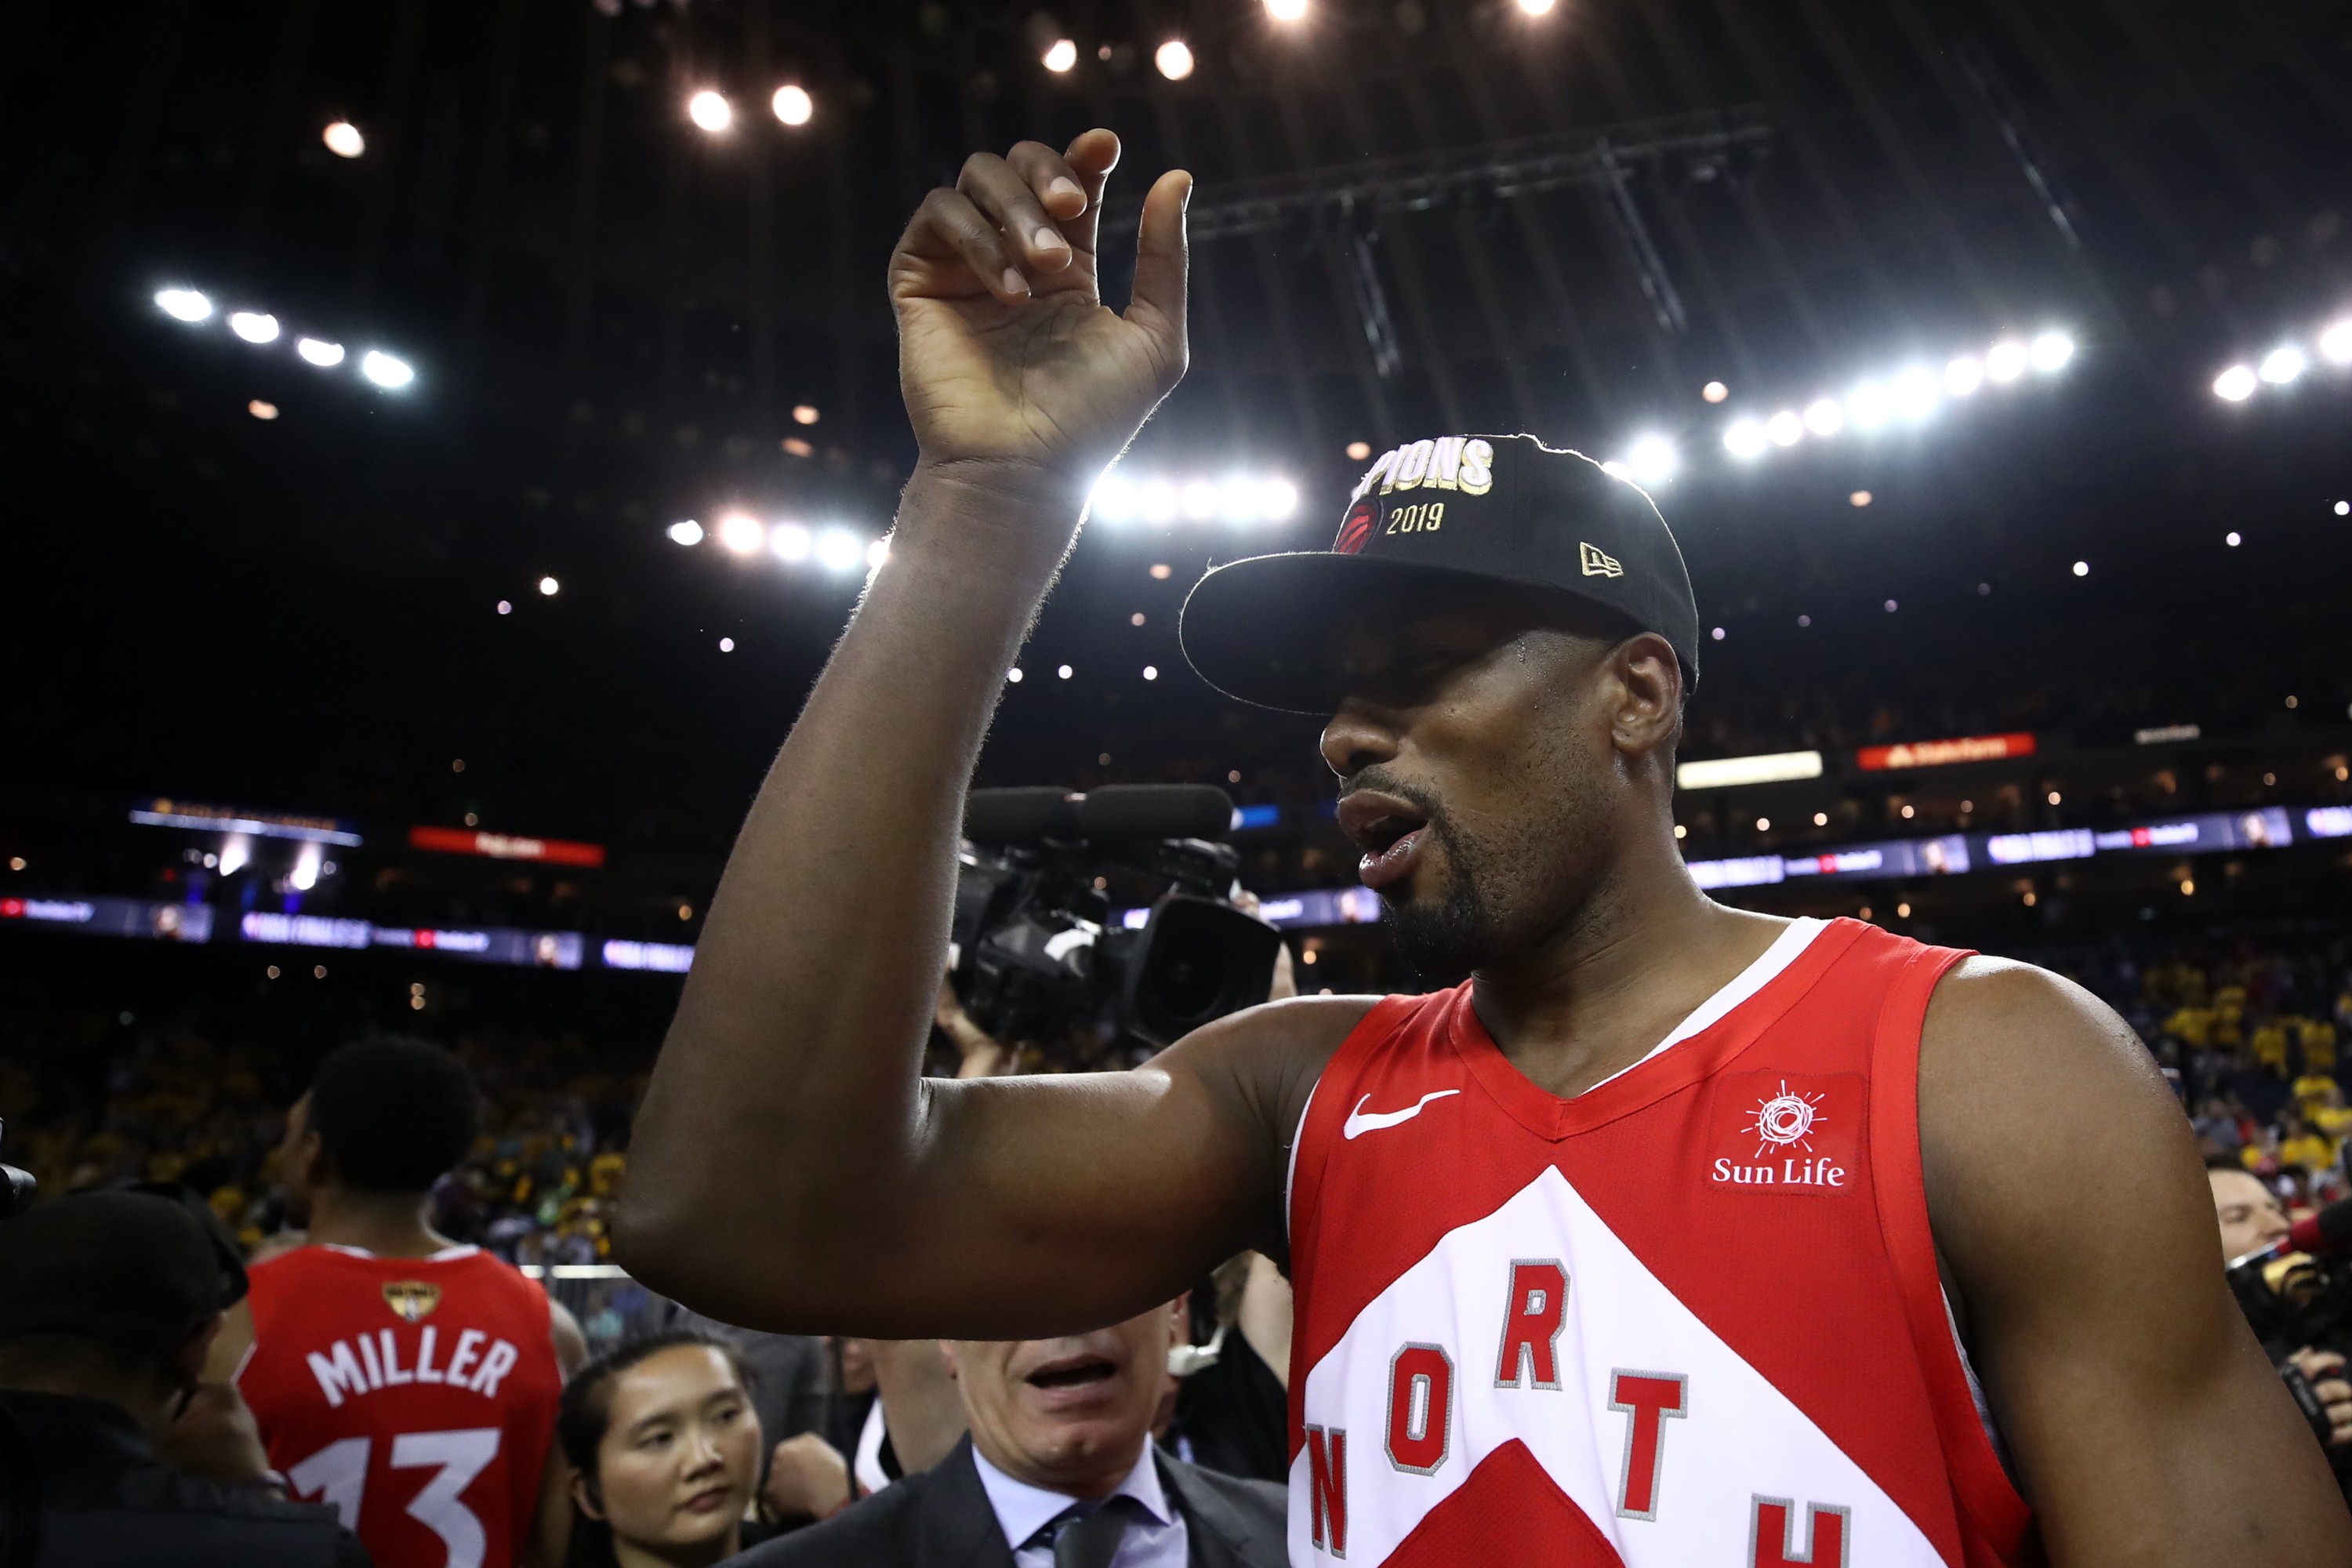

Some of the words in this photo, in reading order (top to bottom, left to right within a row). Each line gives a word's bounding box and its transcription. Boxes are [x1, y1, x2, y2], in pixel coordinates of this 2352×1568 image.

[1386, 503, 1445, 535] 2019
[1712, 1158, 1774, 1182] Sun
[1782, 1157, 1845, 1186] Life
[307, 1325, 518, 1407] MILLER
[288, 1427, 502, 1568] 13
